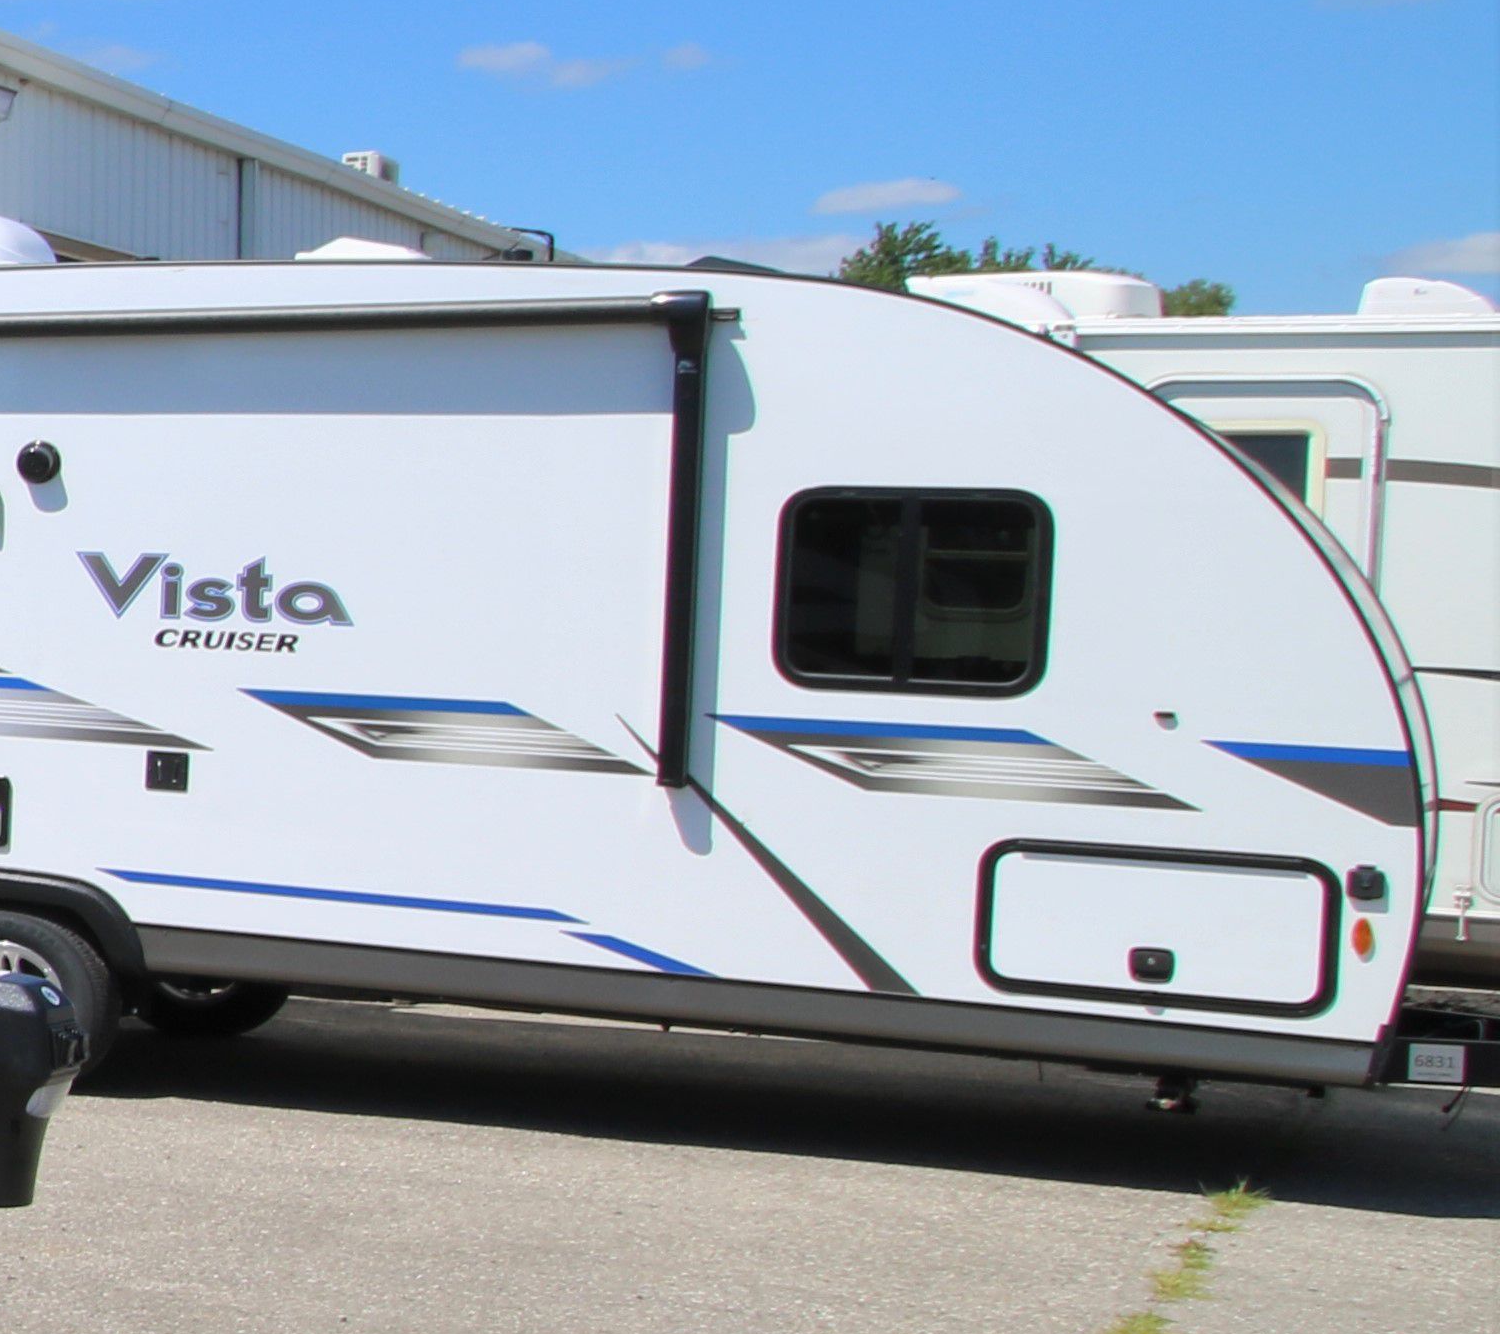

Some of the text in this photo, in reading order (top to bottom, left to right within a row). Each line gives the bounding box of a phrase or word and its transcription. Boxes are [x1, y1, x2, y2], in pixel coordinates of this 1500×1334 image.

[75, 551, 355, 628] Vista
[153, 628, 299, 653] CRUISER
[1414, 1054, 1453, 1068] 6831
